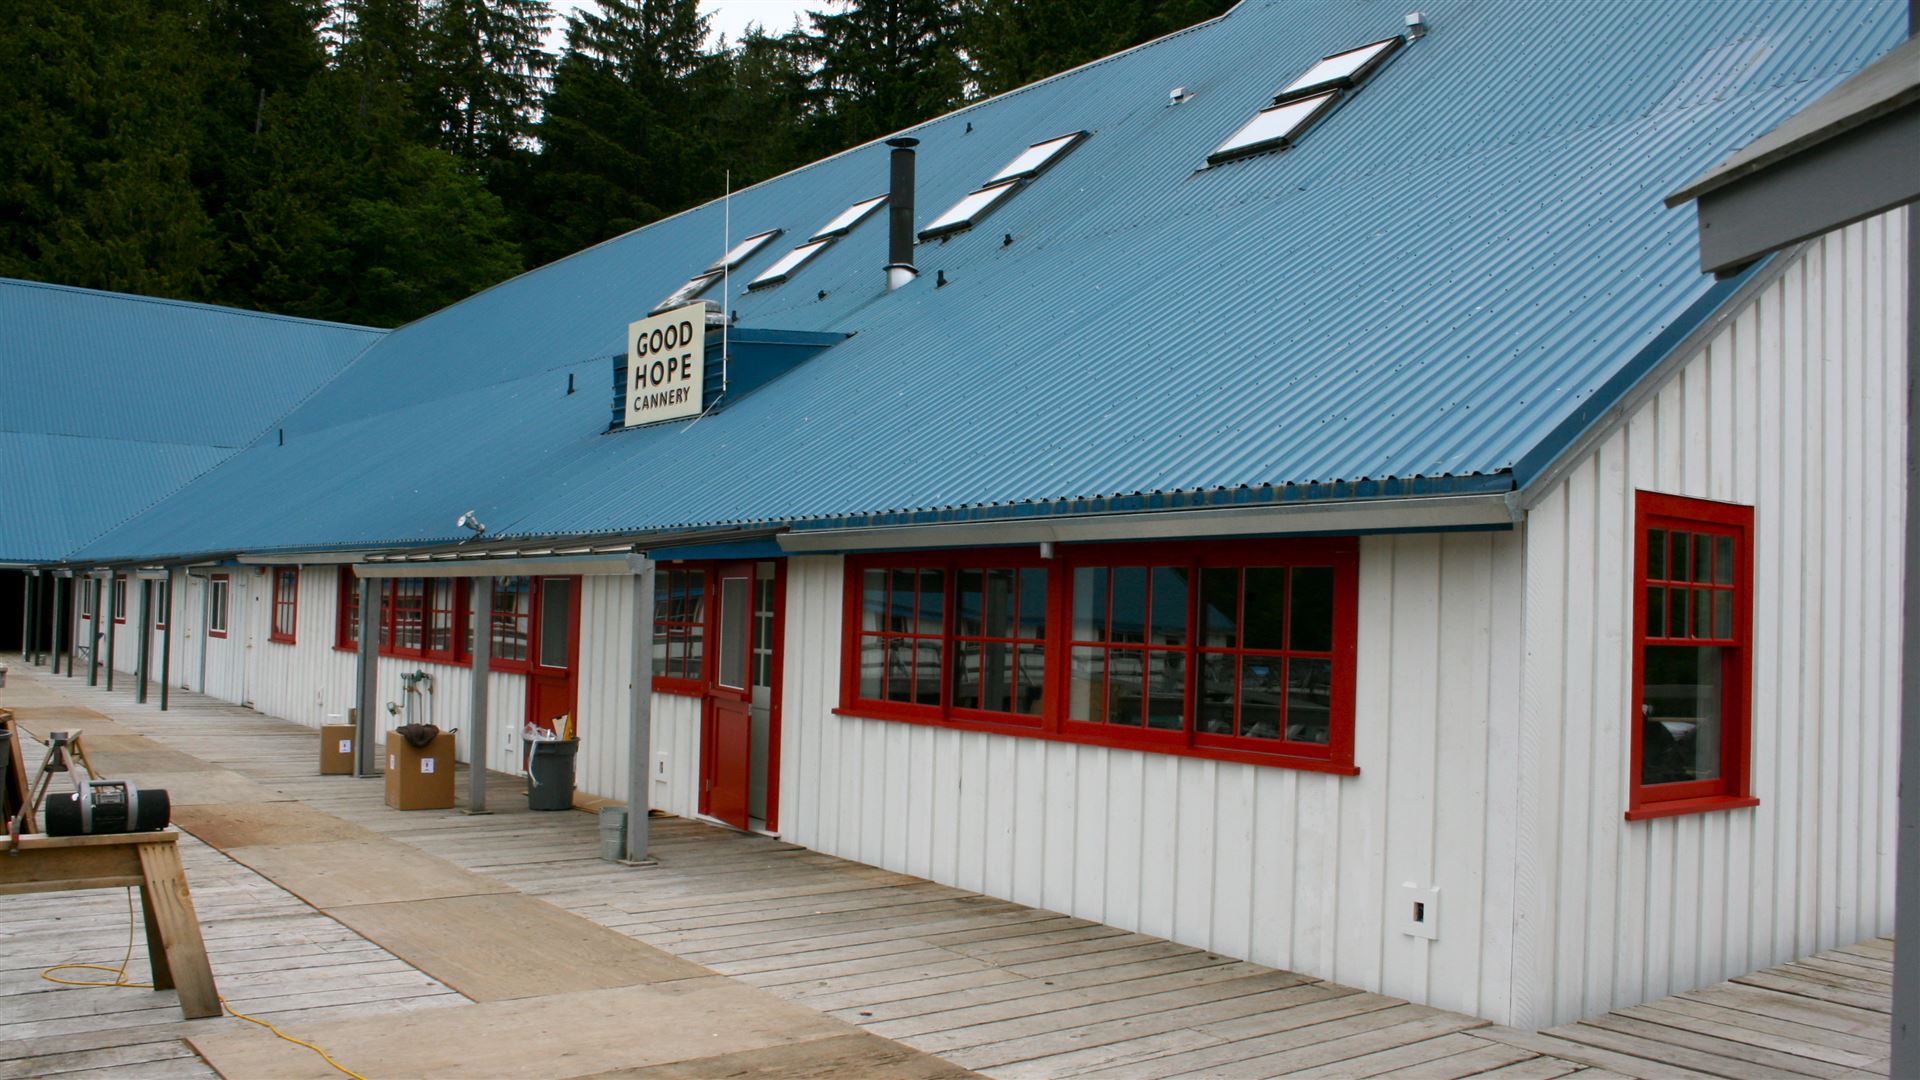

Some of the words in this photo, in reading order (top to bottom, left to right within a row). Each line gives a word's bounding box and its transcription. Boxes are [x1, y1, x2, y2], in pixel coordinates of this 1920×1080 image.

[637, 320, 693, 356] GOOD
[635, 353, 692, 389] HOPE
[633, 386, 691, 412] CANNERY
